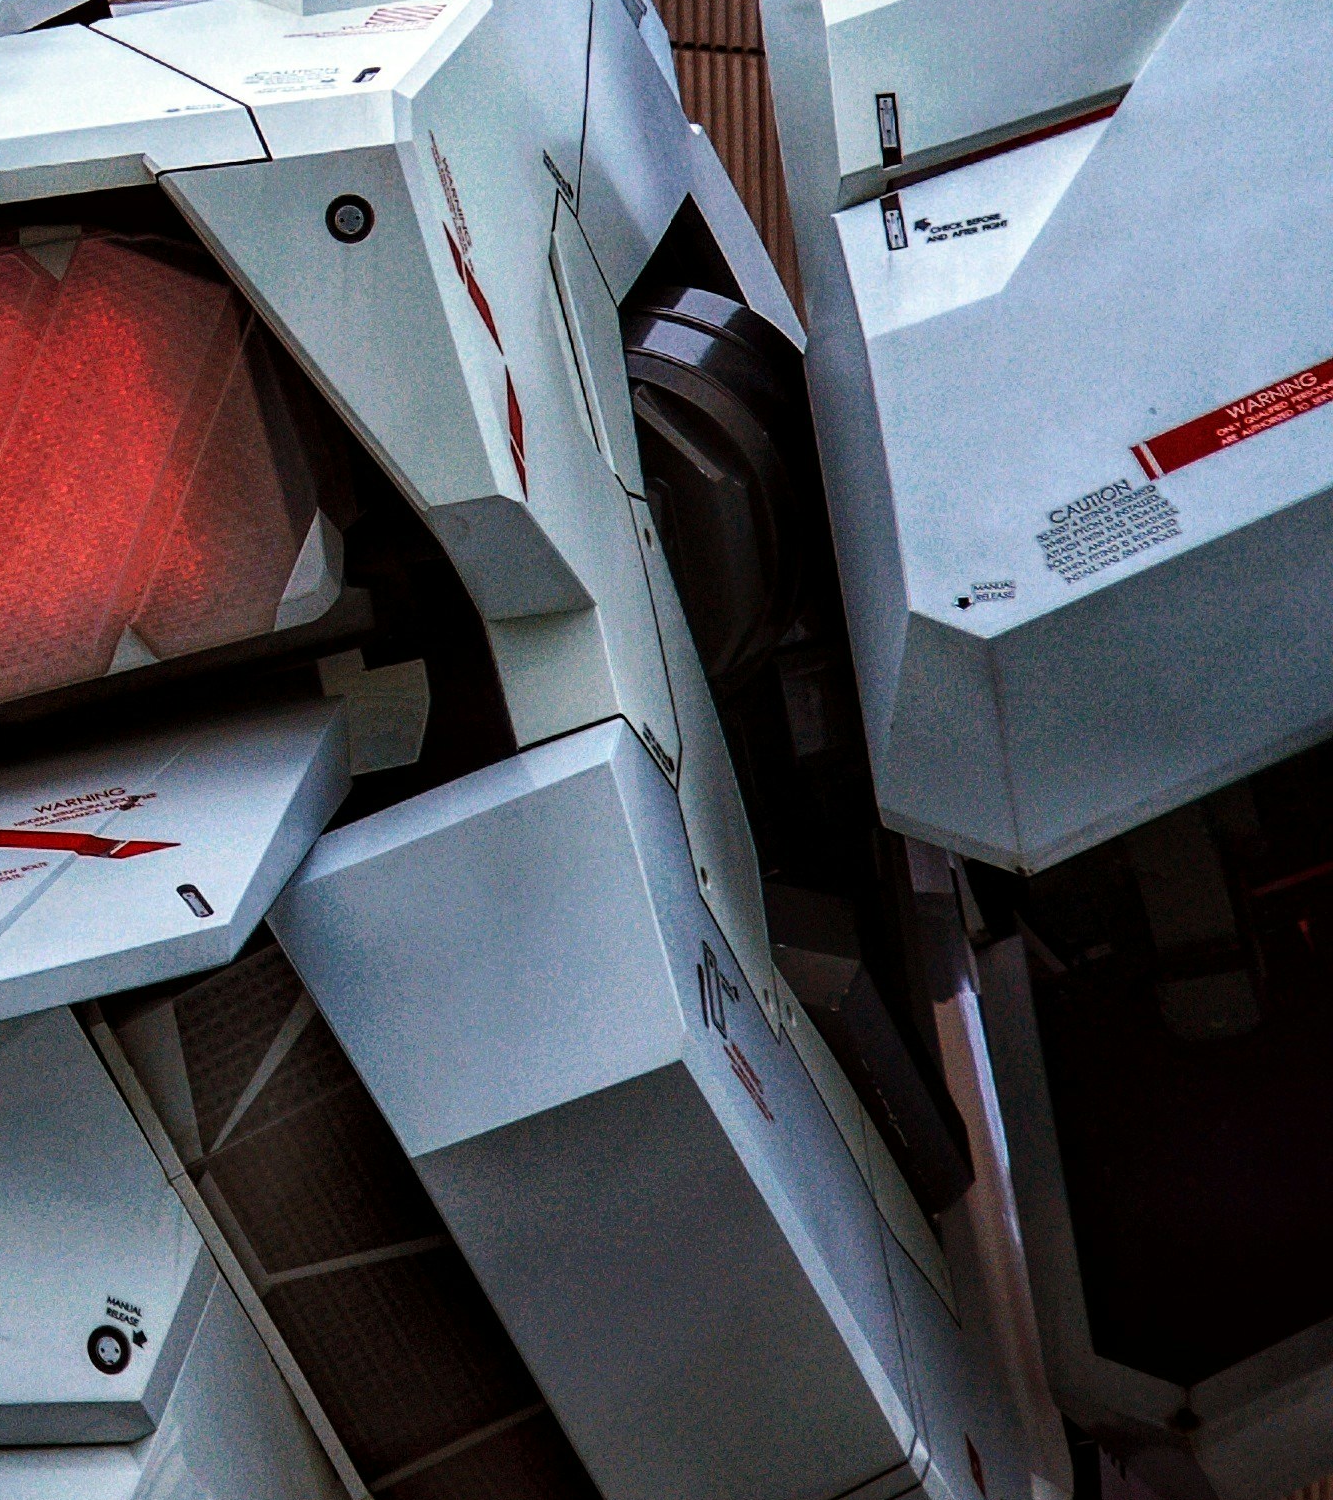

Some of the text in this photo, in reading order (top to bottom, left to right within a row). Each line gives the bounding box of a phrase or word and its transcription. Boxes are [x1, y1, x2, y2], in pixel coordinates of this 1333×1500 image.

[1225, 372, 1317, 419] WARNING
[1049, 479, 1132, 523] CAUTION
[35, 787, 125, 814] WARNING
